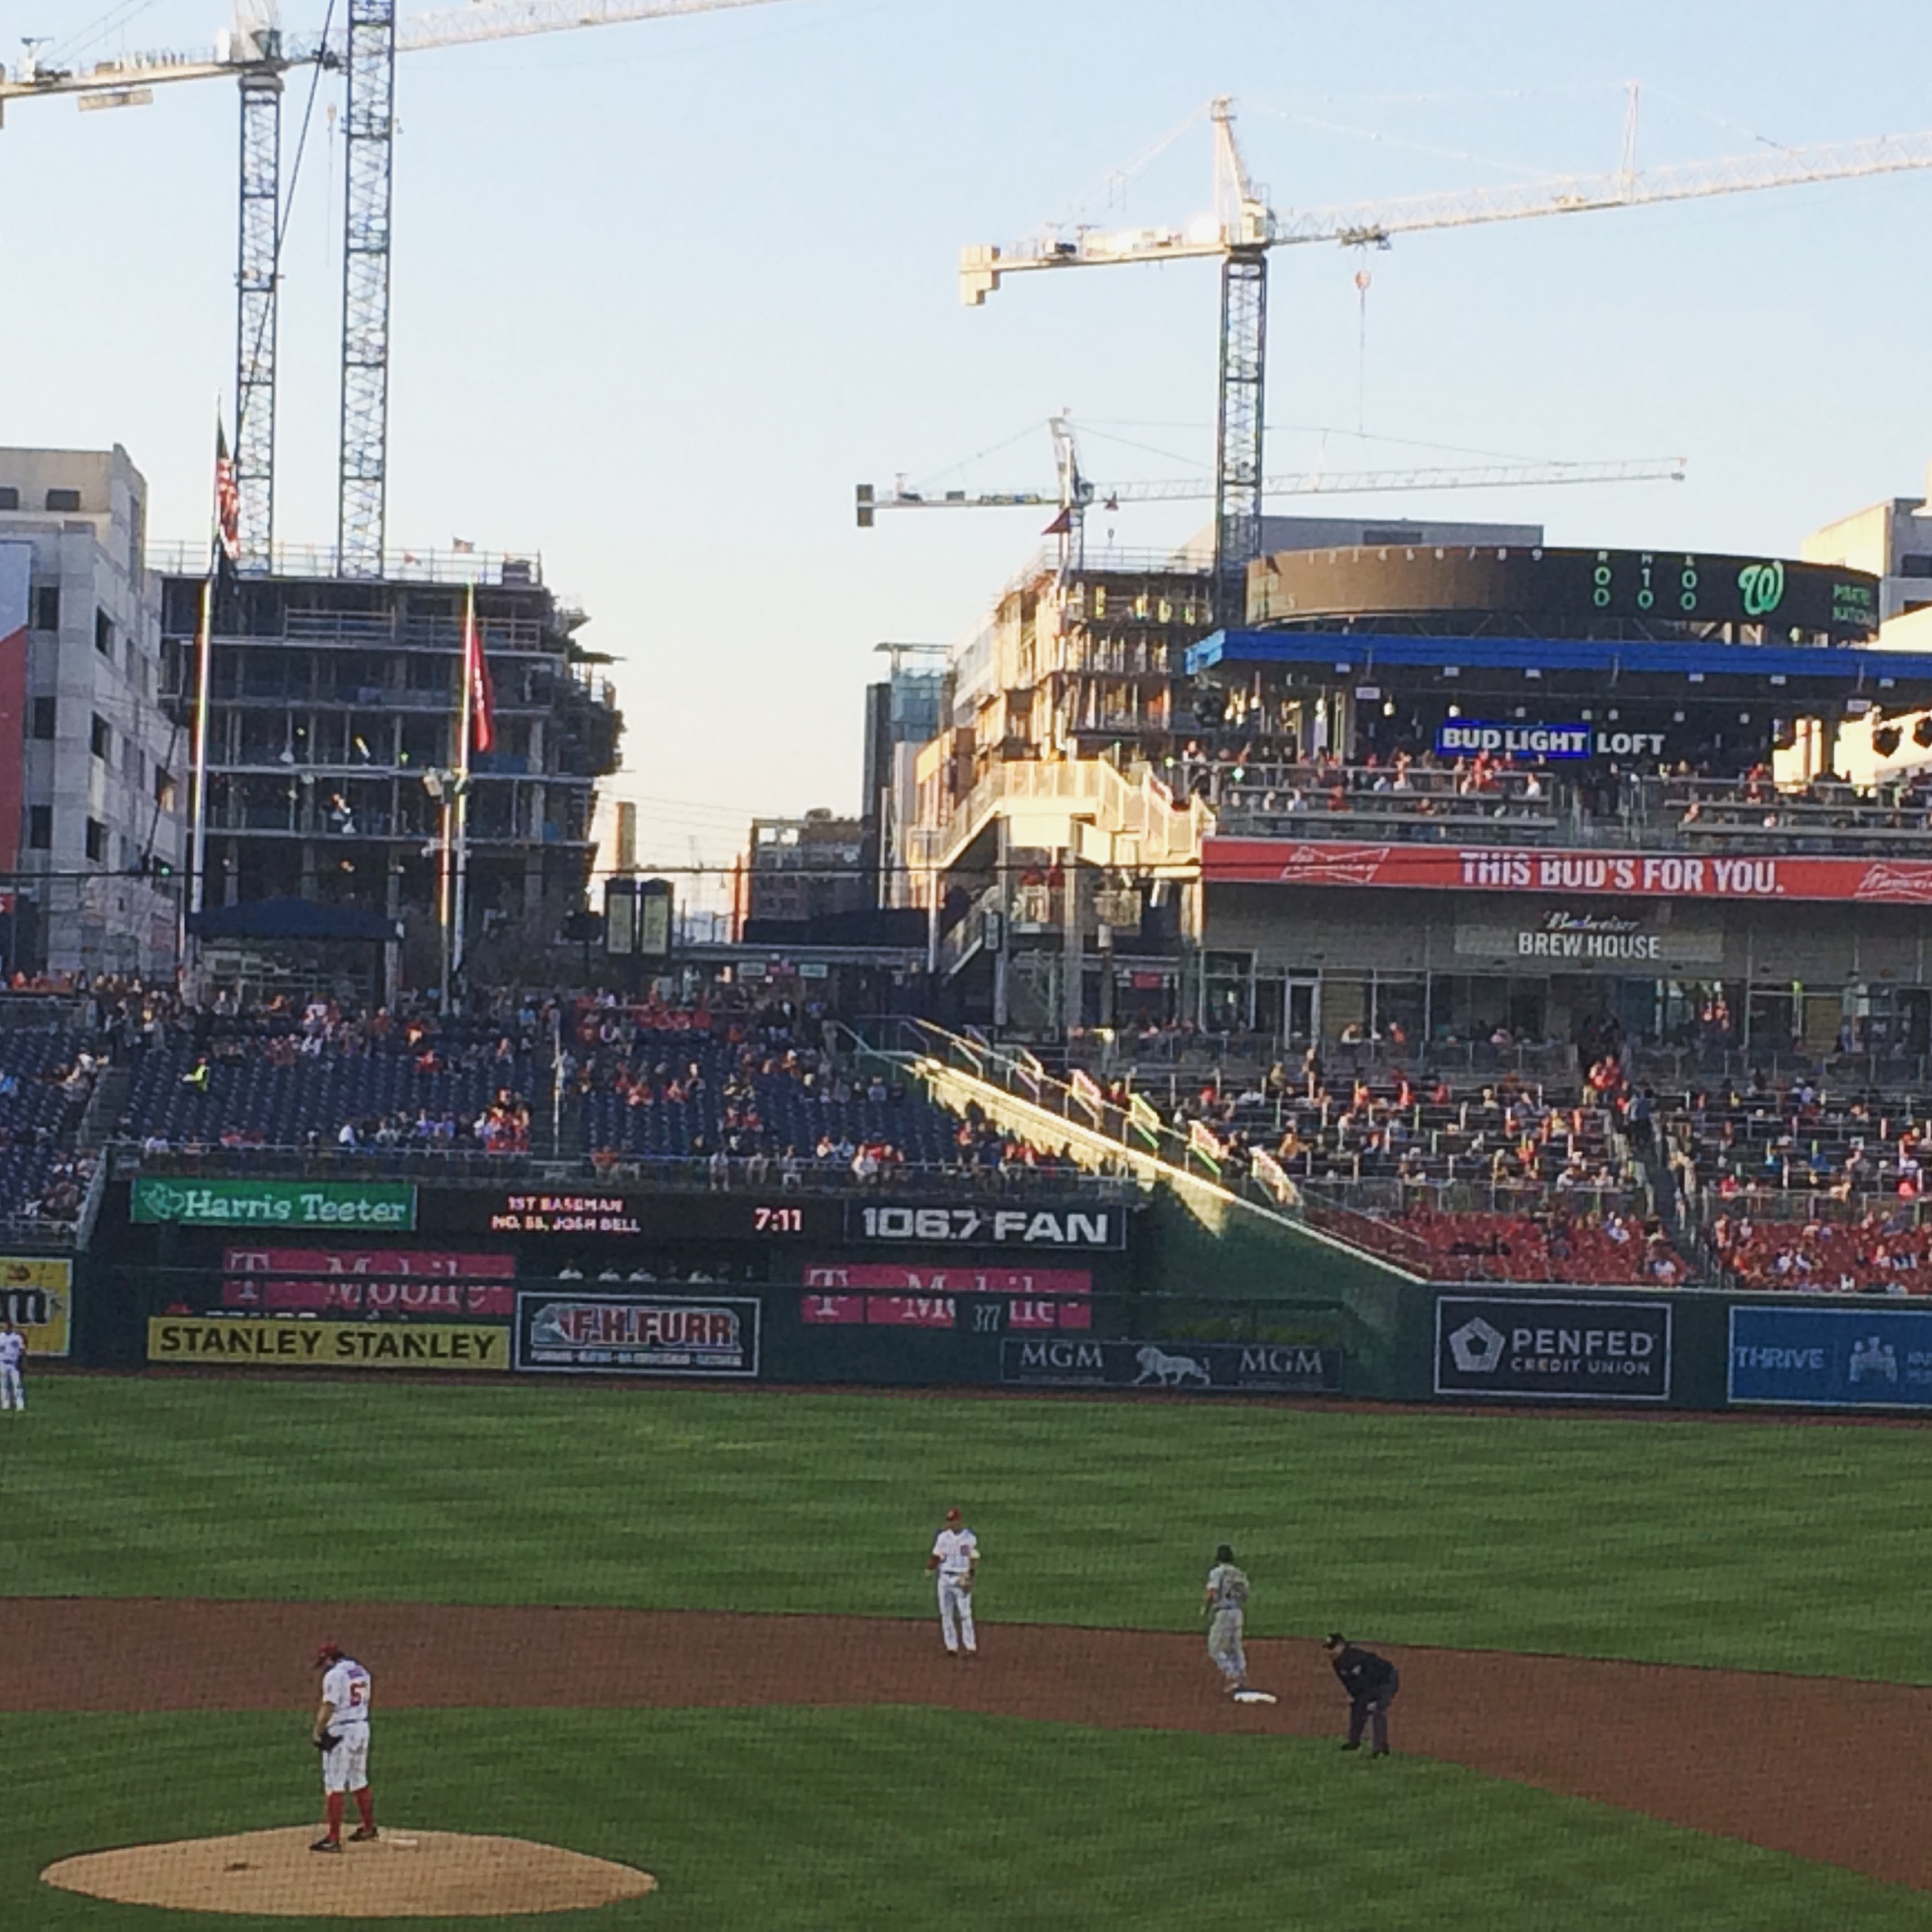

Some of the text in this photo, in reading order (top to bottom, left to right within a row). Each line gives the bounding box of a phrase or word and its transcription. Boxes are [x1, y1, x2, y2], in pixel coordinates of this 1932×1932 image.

[1532, 548, 1543, 561] 9
[1594, 566, 1699, 589] 0 1 0
[1594, 588, 1697, 611] 0 0 0
[1442, 728, 1665, 754] BUD LIGHT LOFT
[1460, 853, 1784, 894] THIS BUD'S FOR YOU.
[1518, 932, 1661, 959] BREW HOUSE
[183, 1189, 406, 1223] Harris Teeter
[508, 1197, 623, 1212] 1ST BASEMAN
[600, 1218, 641, 1232] BELL
[754, 1208, 802, 1231] 7:11
[994, 1212, 1108, 1244] FAN
[972, 1303, 1002, 1334] 377
[161, 1325, 323, 1355] STANLEY
[335, 1331, 497, 1359] STANLEY
[1513, 1328, 1654, 1356] PENFED
[1021, 1343, 1104, 1368] MGM
[1239, 1348, 1324, 1374] MGM
[1510, 1357, 1650, 1376] CREDIT UNION
[1734, 1345, 1824, 1369] THRIVE
